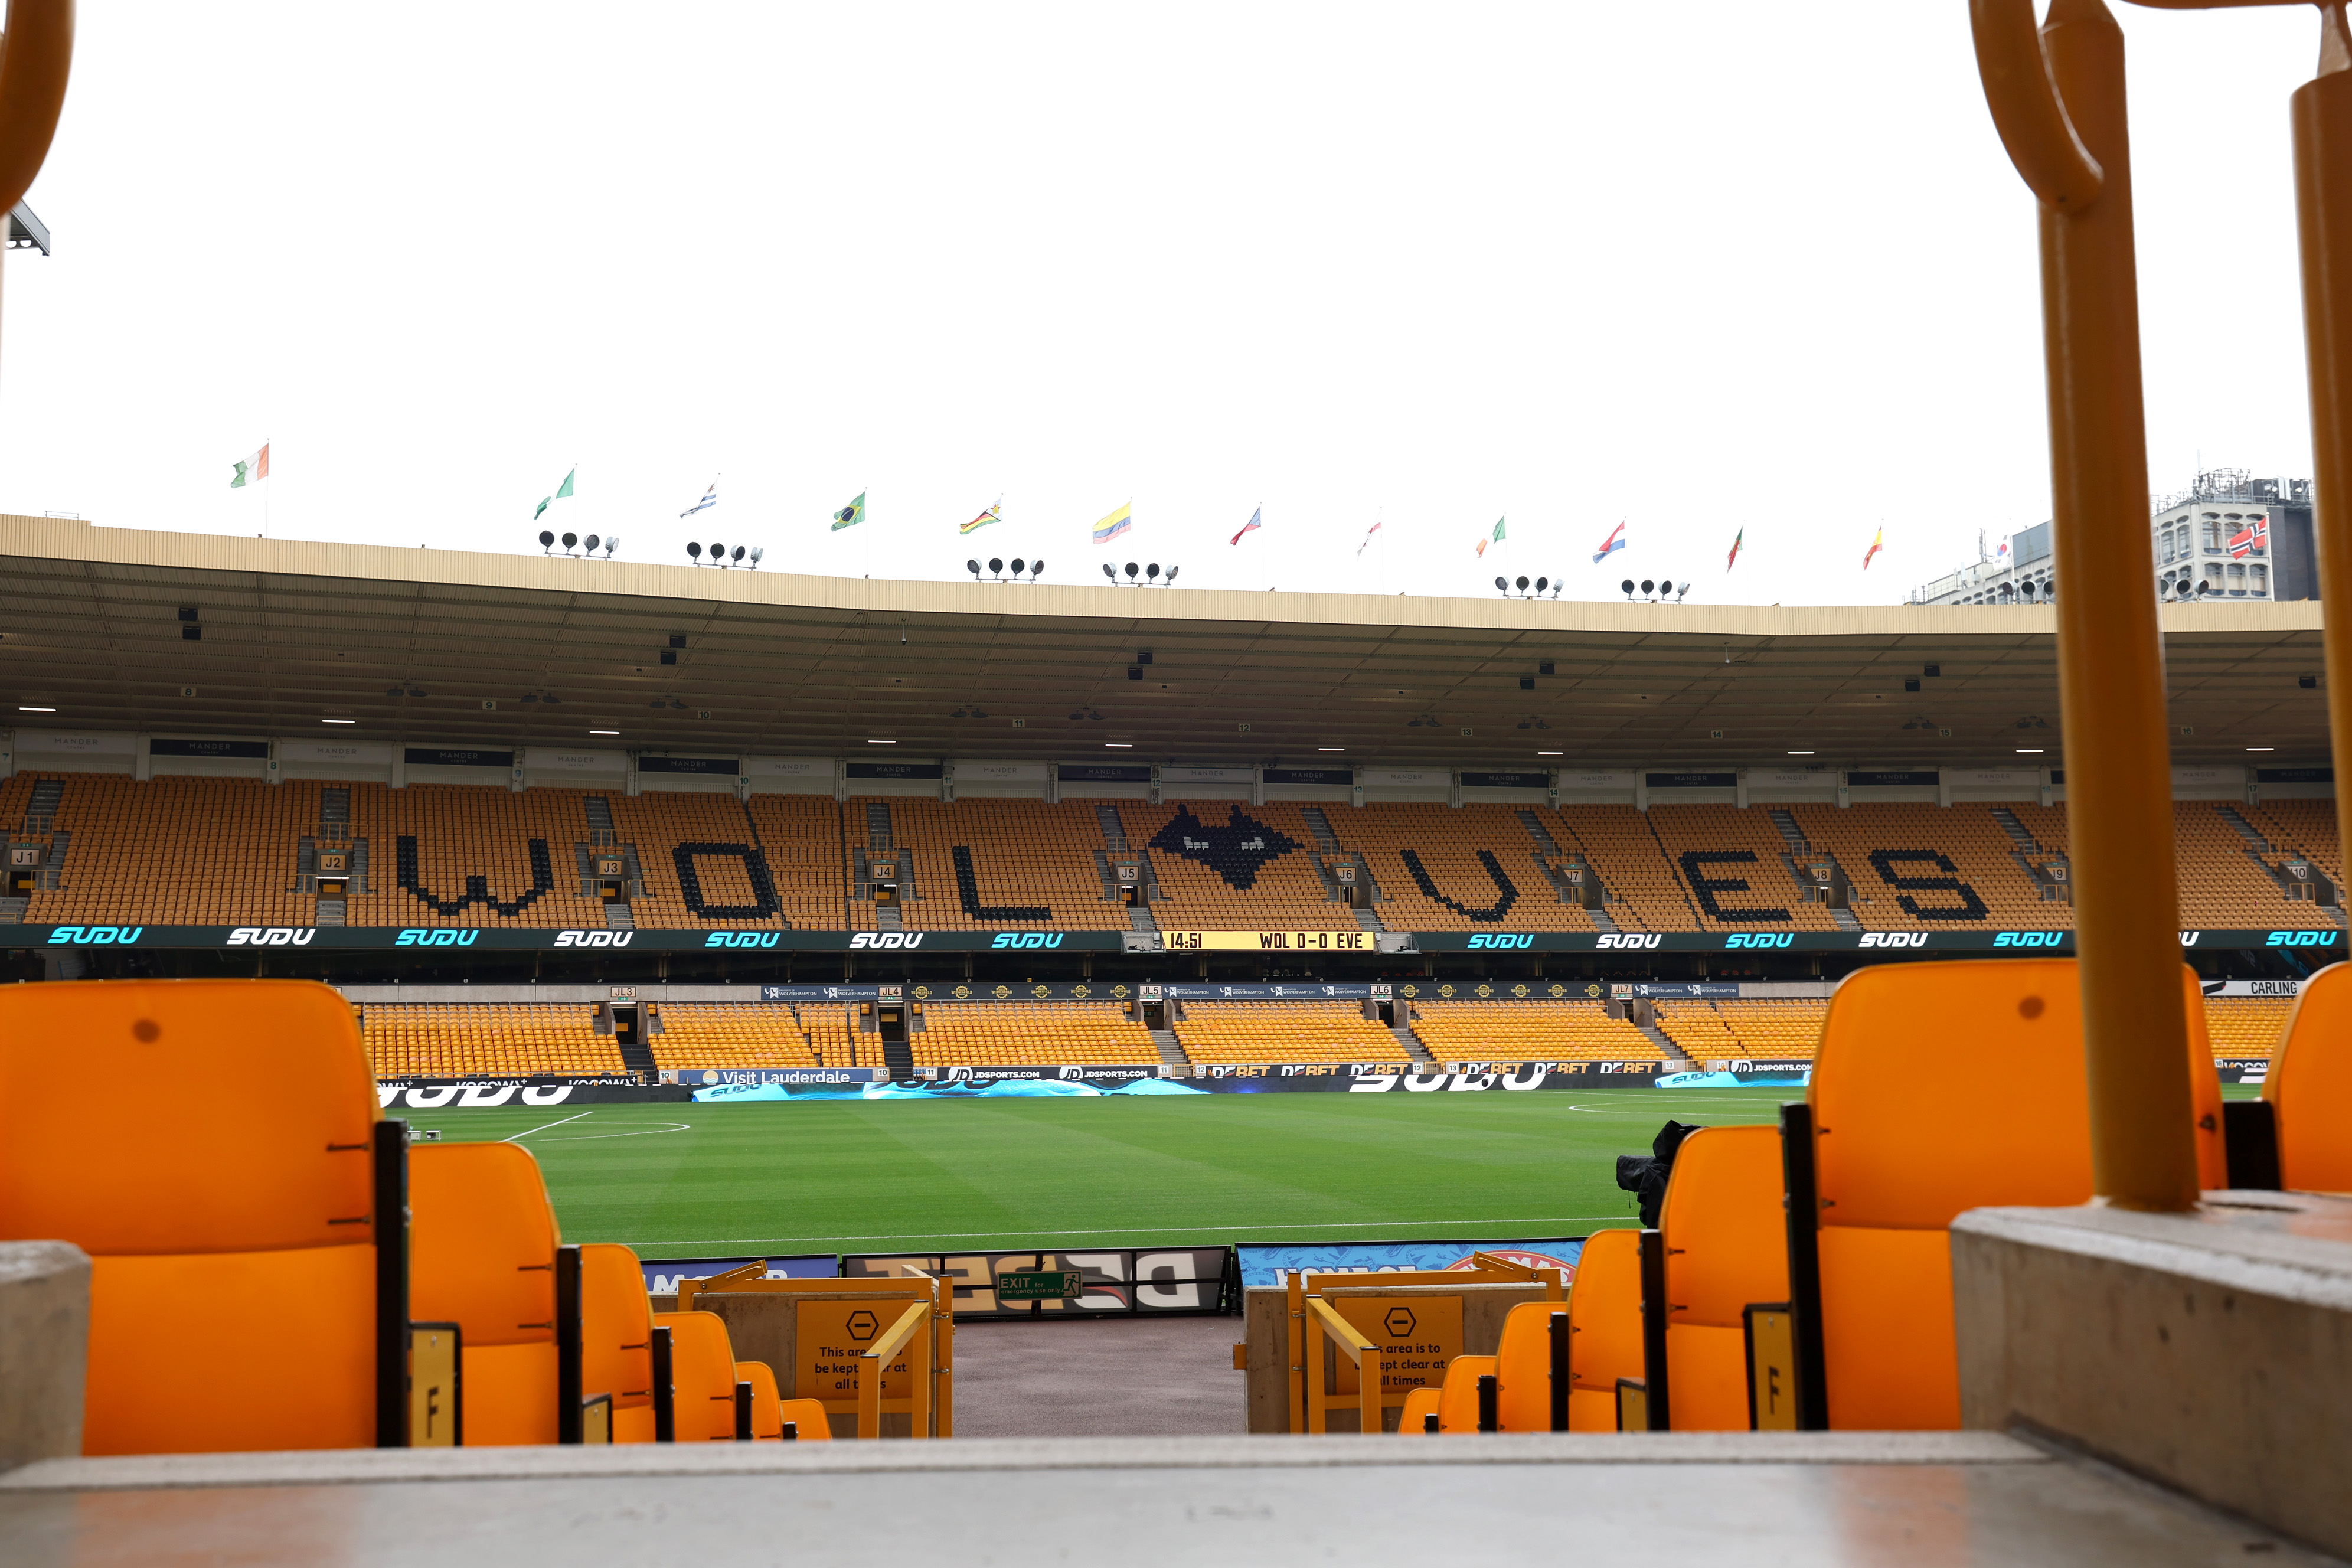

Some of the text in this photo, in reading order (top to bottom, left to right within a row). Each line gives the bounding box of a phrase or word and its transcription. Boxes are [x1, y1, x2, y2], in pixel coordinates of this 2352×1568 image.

[326, 857, 340, 868] J2
[603, 863, 618, 873] J3
[877, 866, 890, 876] J4
[1122, 868, 1135, 878] J5
[1340, 870, 1353, 880] J6
[1568, 871, 1579, 881] J7
[1815, 870, 1827, 880] J8
[2052, 869, 2063, 878] J9
[48, 927, 143, 944] SUDU
[227, 928, 316, 945] SUDU
[396, 930, 479, 946] SUDU
[554, 931, 633, 946] SUDU
[705, 932, 780, 947] SUDU
[850, 933, 923, 948] SUDU
[991, 933, 1063, 948] SUDU
[1171, 933, 1202, 948] 14:51
[1260, 933, 1363, 949] WOL 0-0 EVE
[1468, 934, 1534, 948] SUDU
[1596, 934, 1662, 948] SUDU
[1725, 933, 1794, 948] SUDU
[1858, 933, 1928, 947] SUDU
[1994, 932, 2063, 946] SUDU
[2266, 932, 2337, 945] SUDU
[615, 988, 632, 996] JL3
[1142, 986, 1159, 995] JL5
[1373, 986, 1389, 994] JL6
[1615, 985, 1629, 994] JL7
[2251, 982, 2297, 994] CARLING
[723, 1071, 850, 1083] Visit Lauderdale
[1001, 1278, 1030, 1288] EXIT
[819, 1347, 844, 1357] This
[1416, 1343, 1425, 1353] is
[1428, 1344, 1440, 1353] to
[815, 1363, 858, 1376] be kept
[894, 1363, 907, 1373] at
[1380, 1359, 1446, 1372] ept clear at
[835, 1379, 850, 1389] all
[1393, 1376, 1426, 1386] times
[1768, 1366, 1780, 1415] F
[427, 1386, 440, 1439] F
